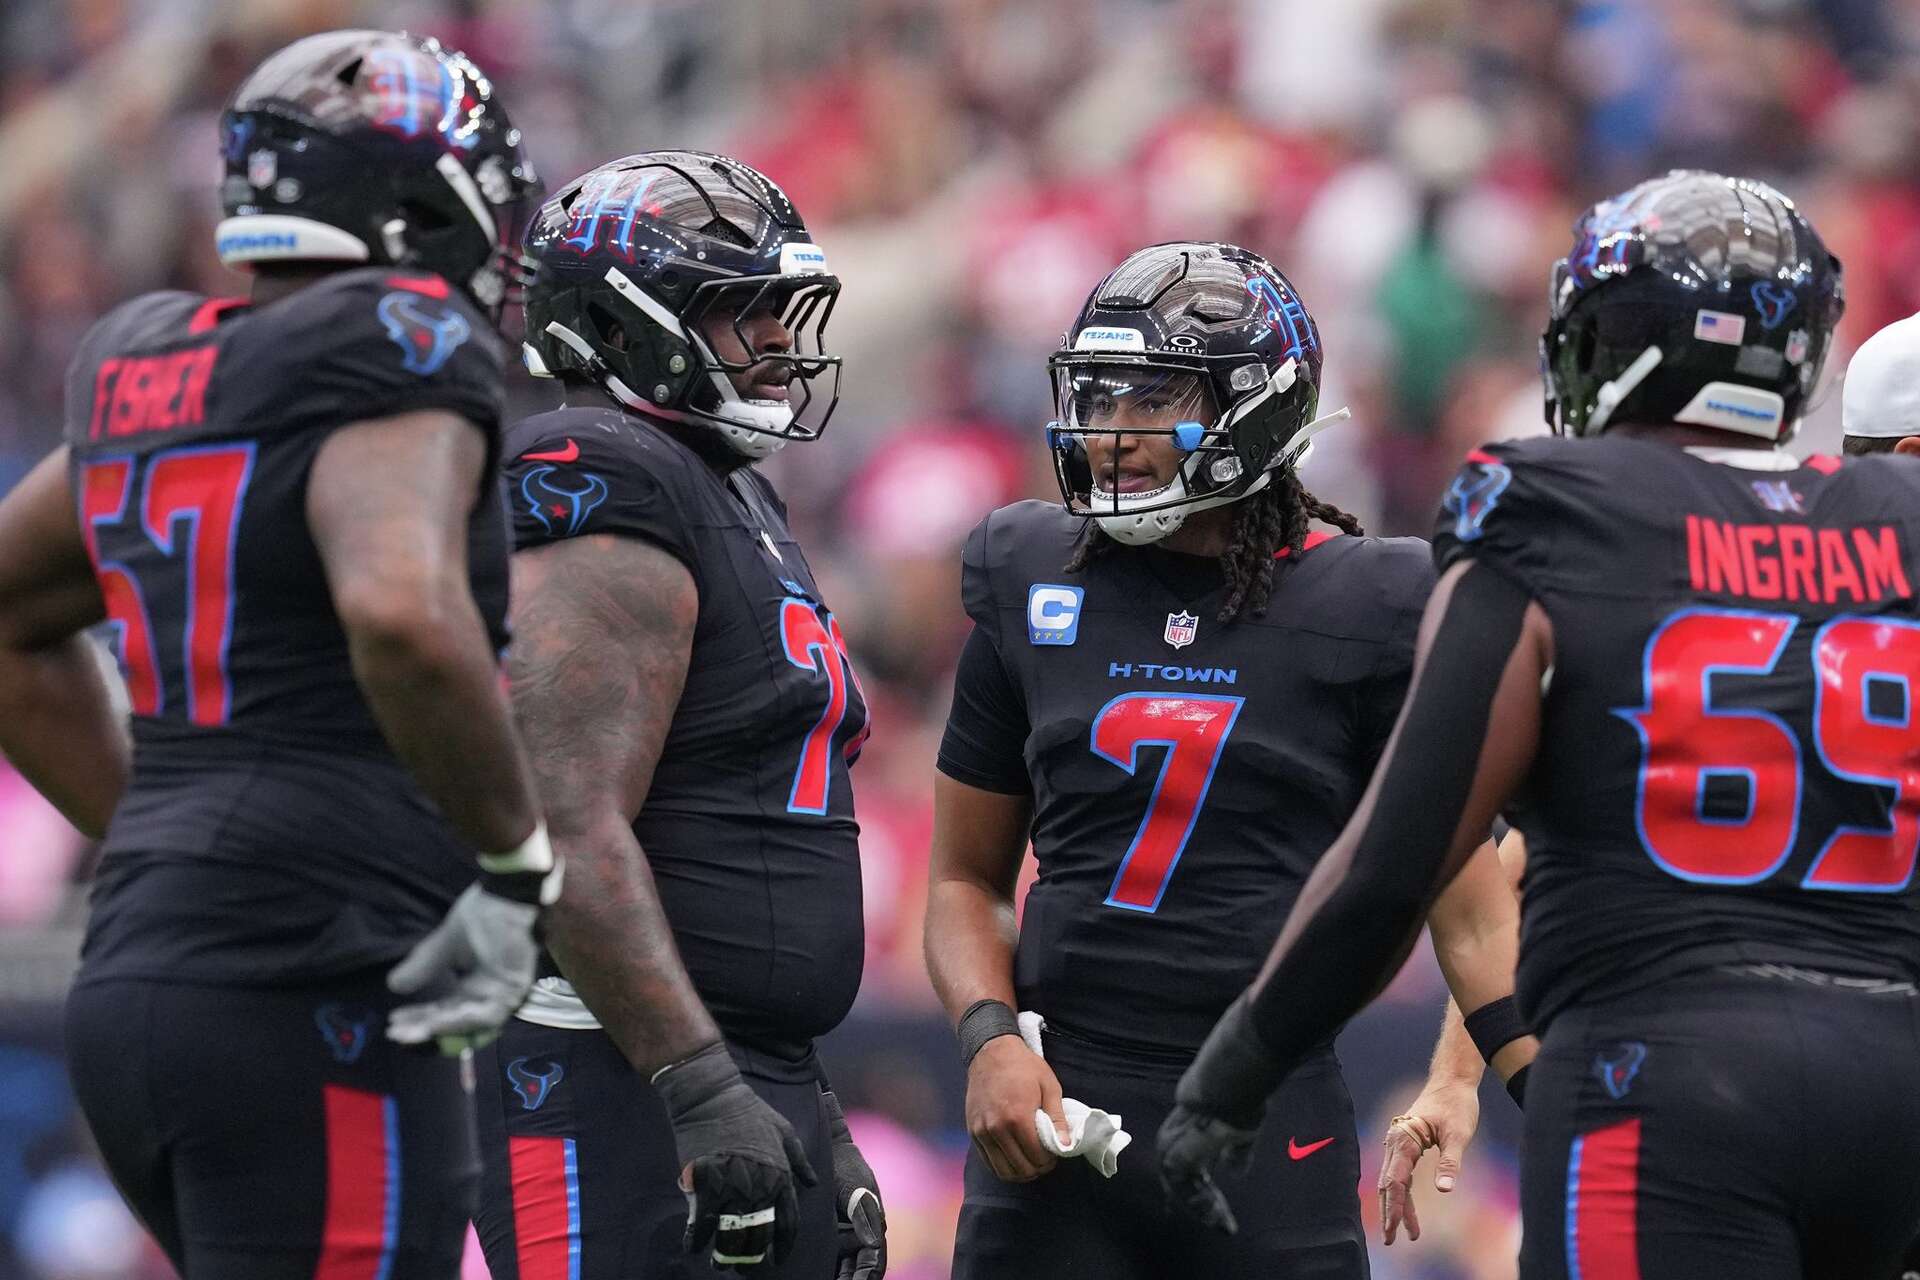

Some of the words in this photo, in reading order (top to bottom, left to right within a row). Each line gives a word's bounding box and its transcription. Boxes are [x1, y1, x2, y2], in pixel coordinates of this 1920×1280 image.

[1083, 331, 1135, 341] TEXANS
[1162, 344, 1204, 354] OAKLEY
[91, 345, 220, 441] FISHER
[1685, 514, 1912, 604] INGRAM
[1030, 588, 1078, 630] C
[1108, 662, 1237, 684] H-TOWN
[1609, 606, 1920, 893] 69
[1090, 691, 1246, 914] 7
